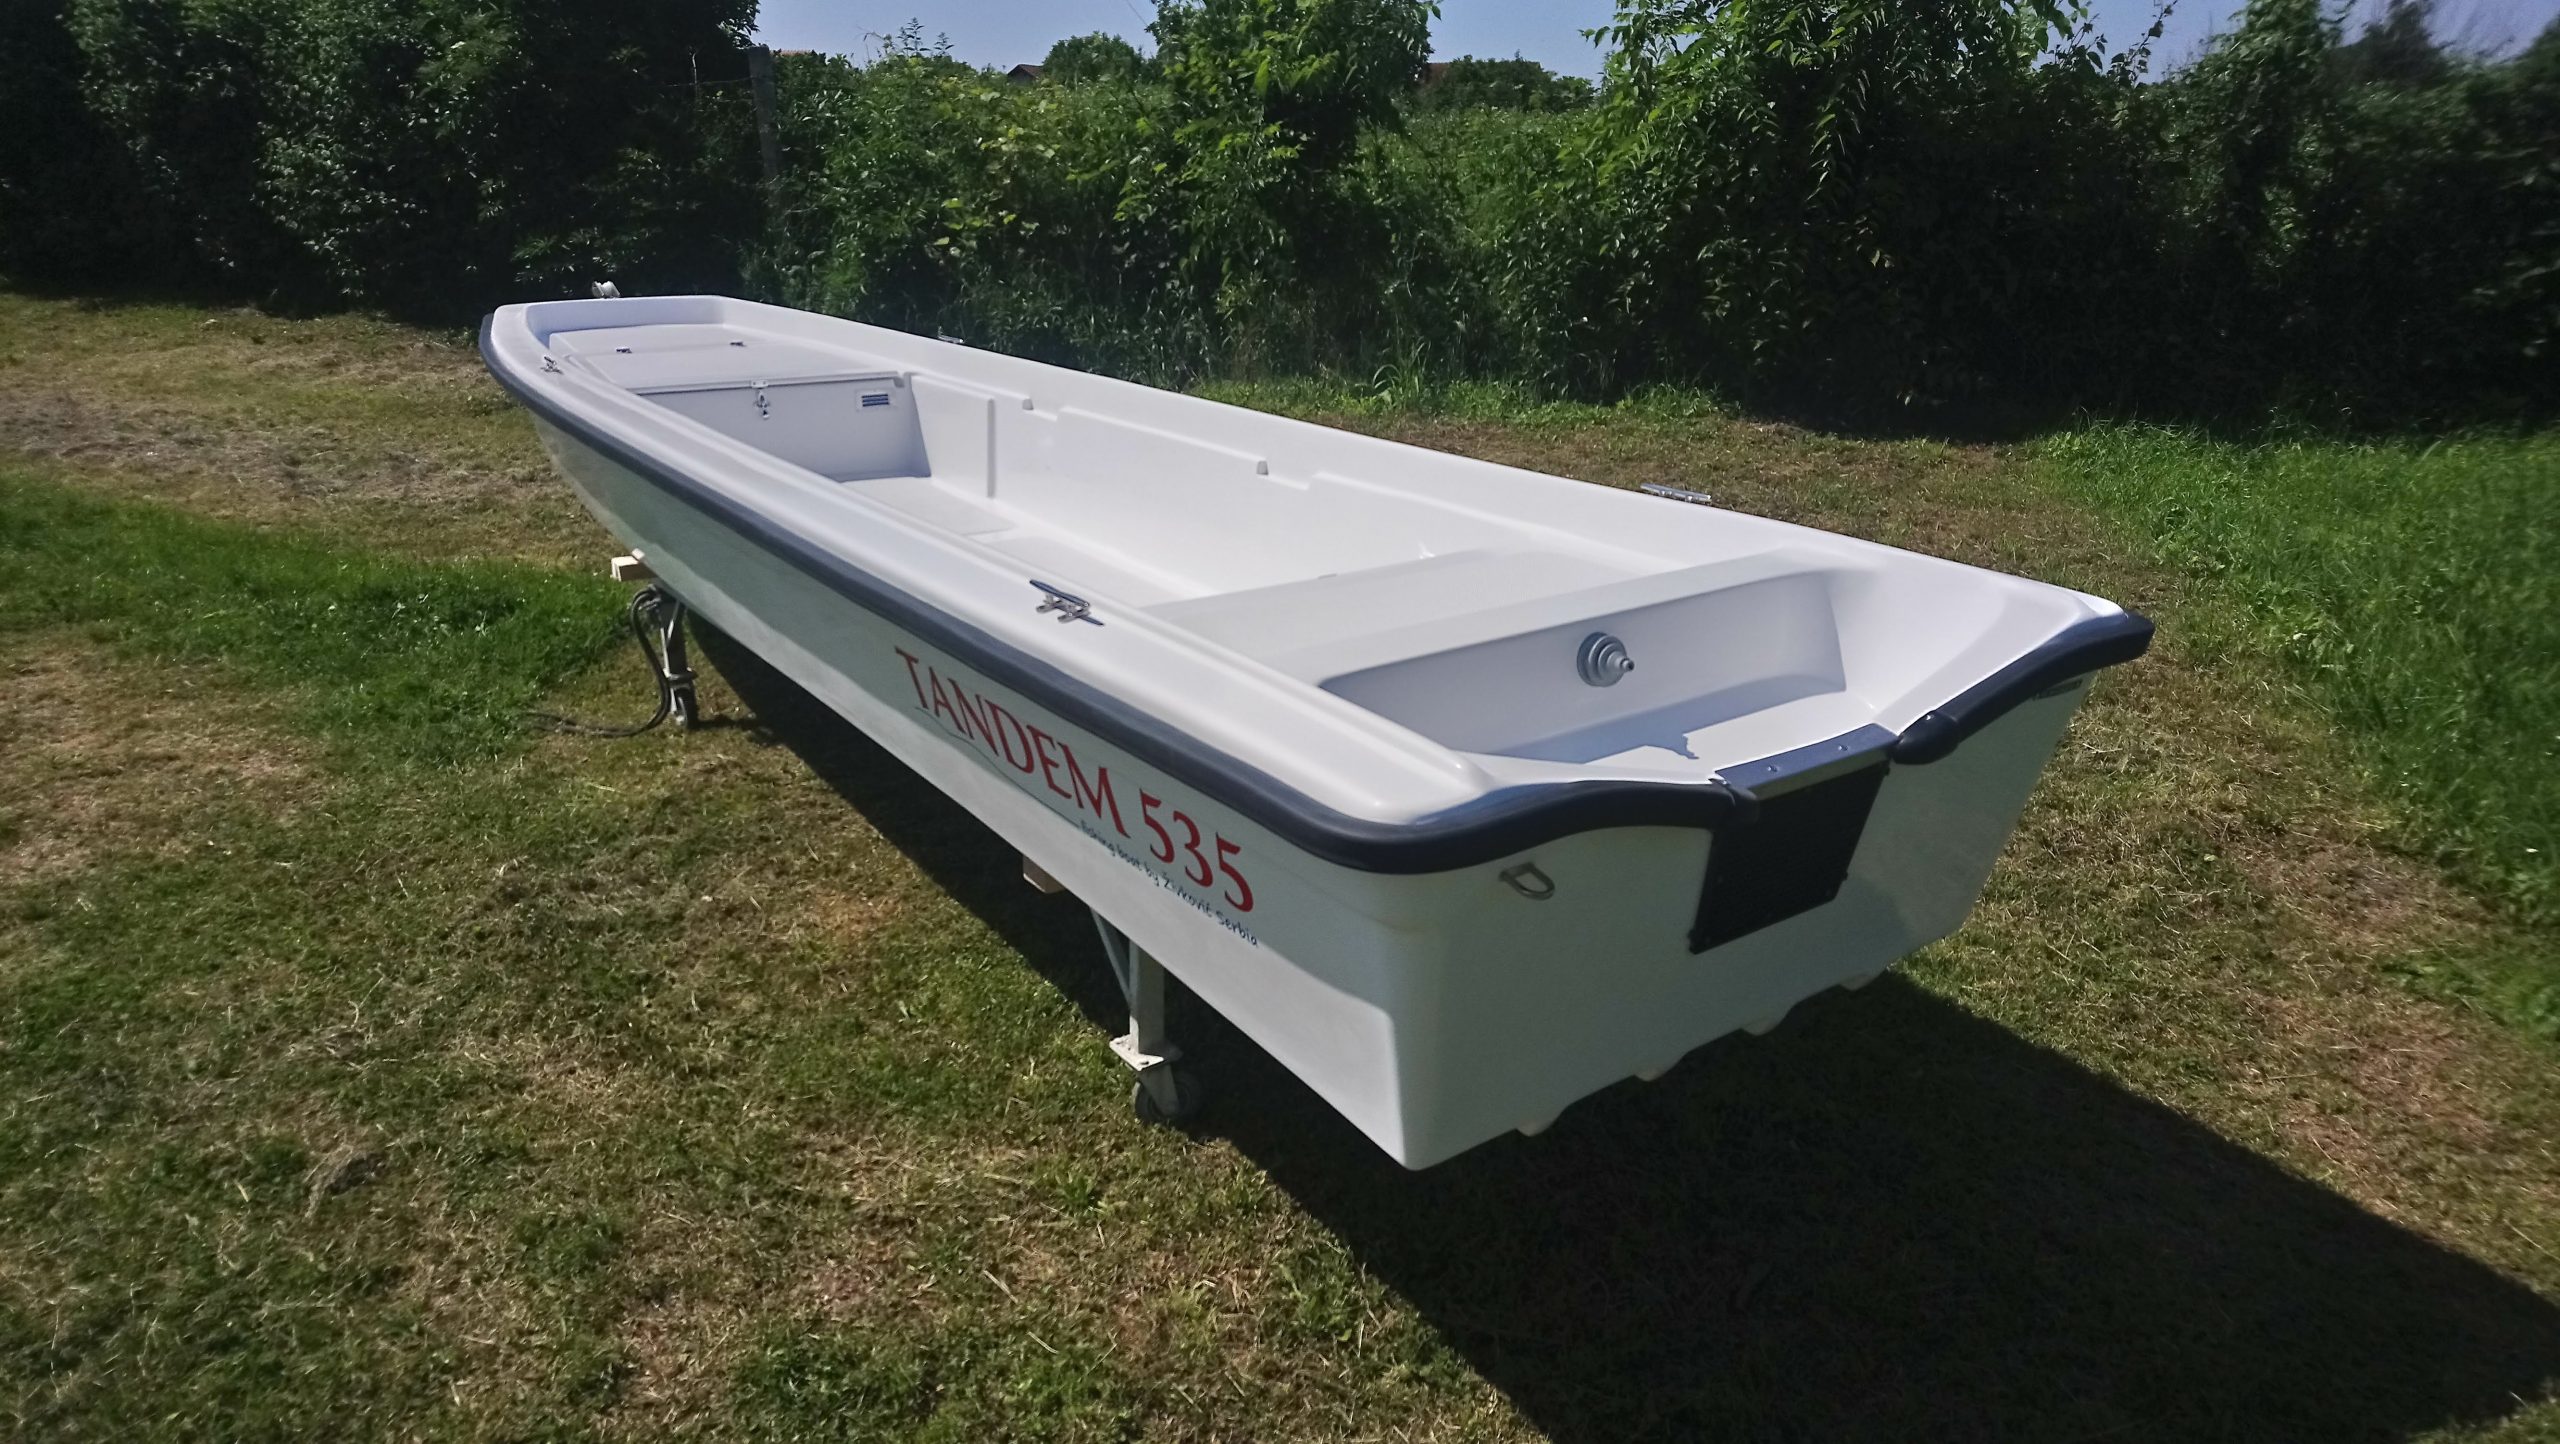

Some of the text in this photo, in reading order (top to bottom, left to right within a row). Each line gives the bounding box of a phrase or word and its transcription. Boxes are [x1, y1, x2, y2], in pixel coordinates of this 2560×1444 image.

[894, 645, 1254, 913] TANDEM 535
[1115, 844, 1142, 872] boat
[1143, 861, 1160, 887] by
[1215, 910, 1259, 948] Serbia
